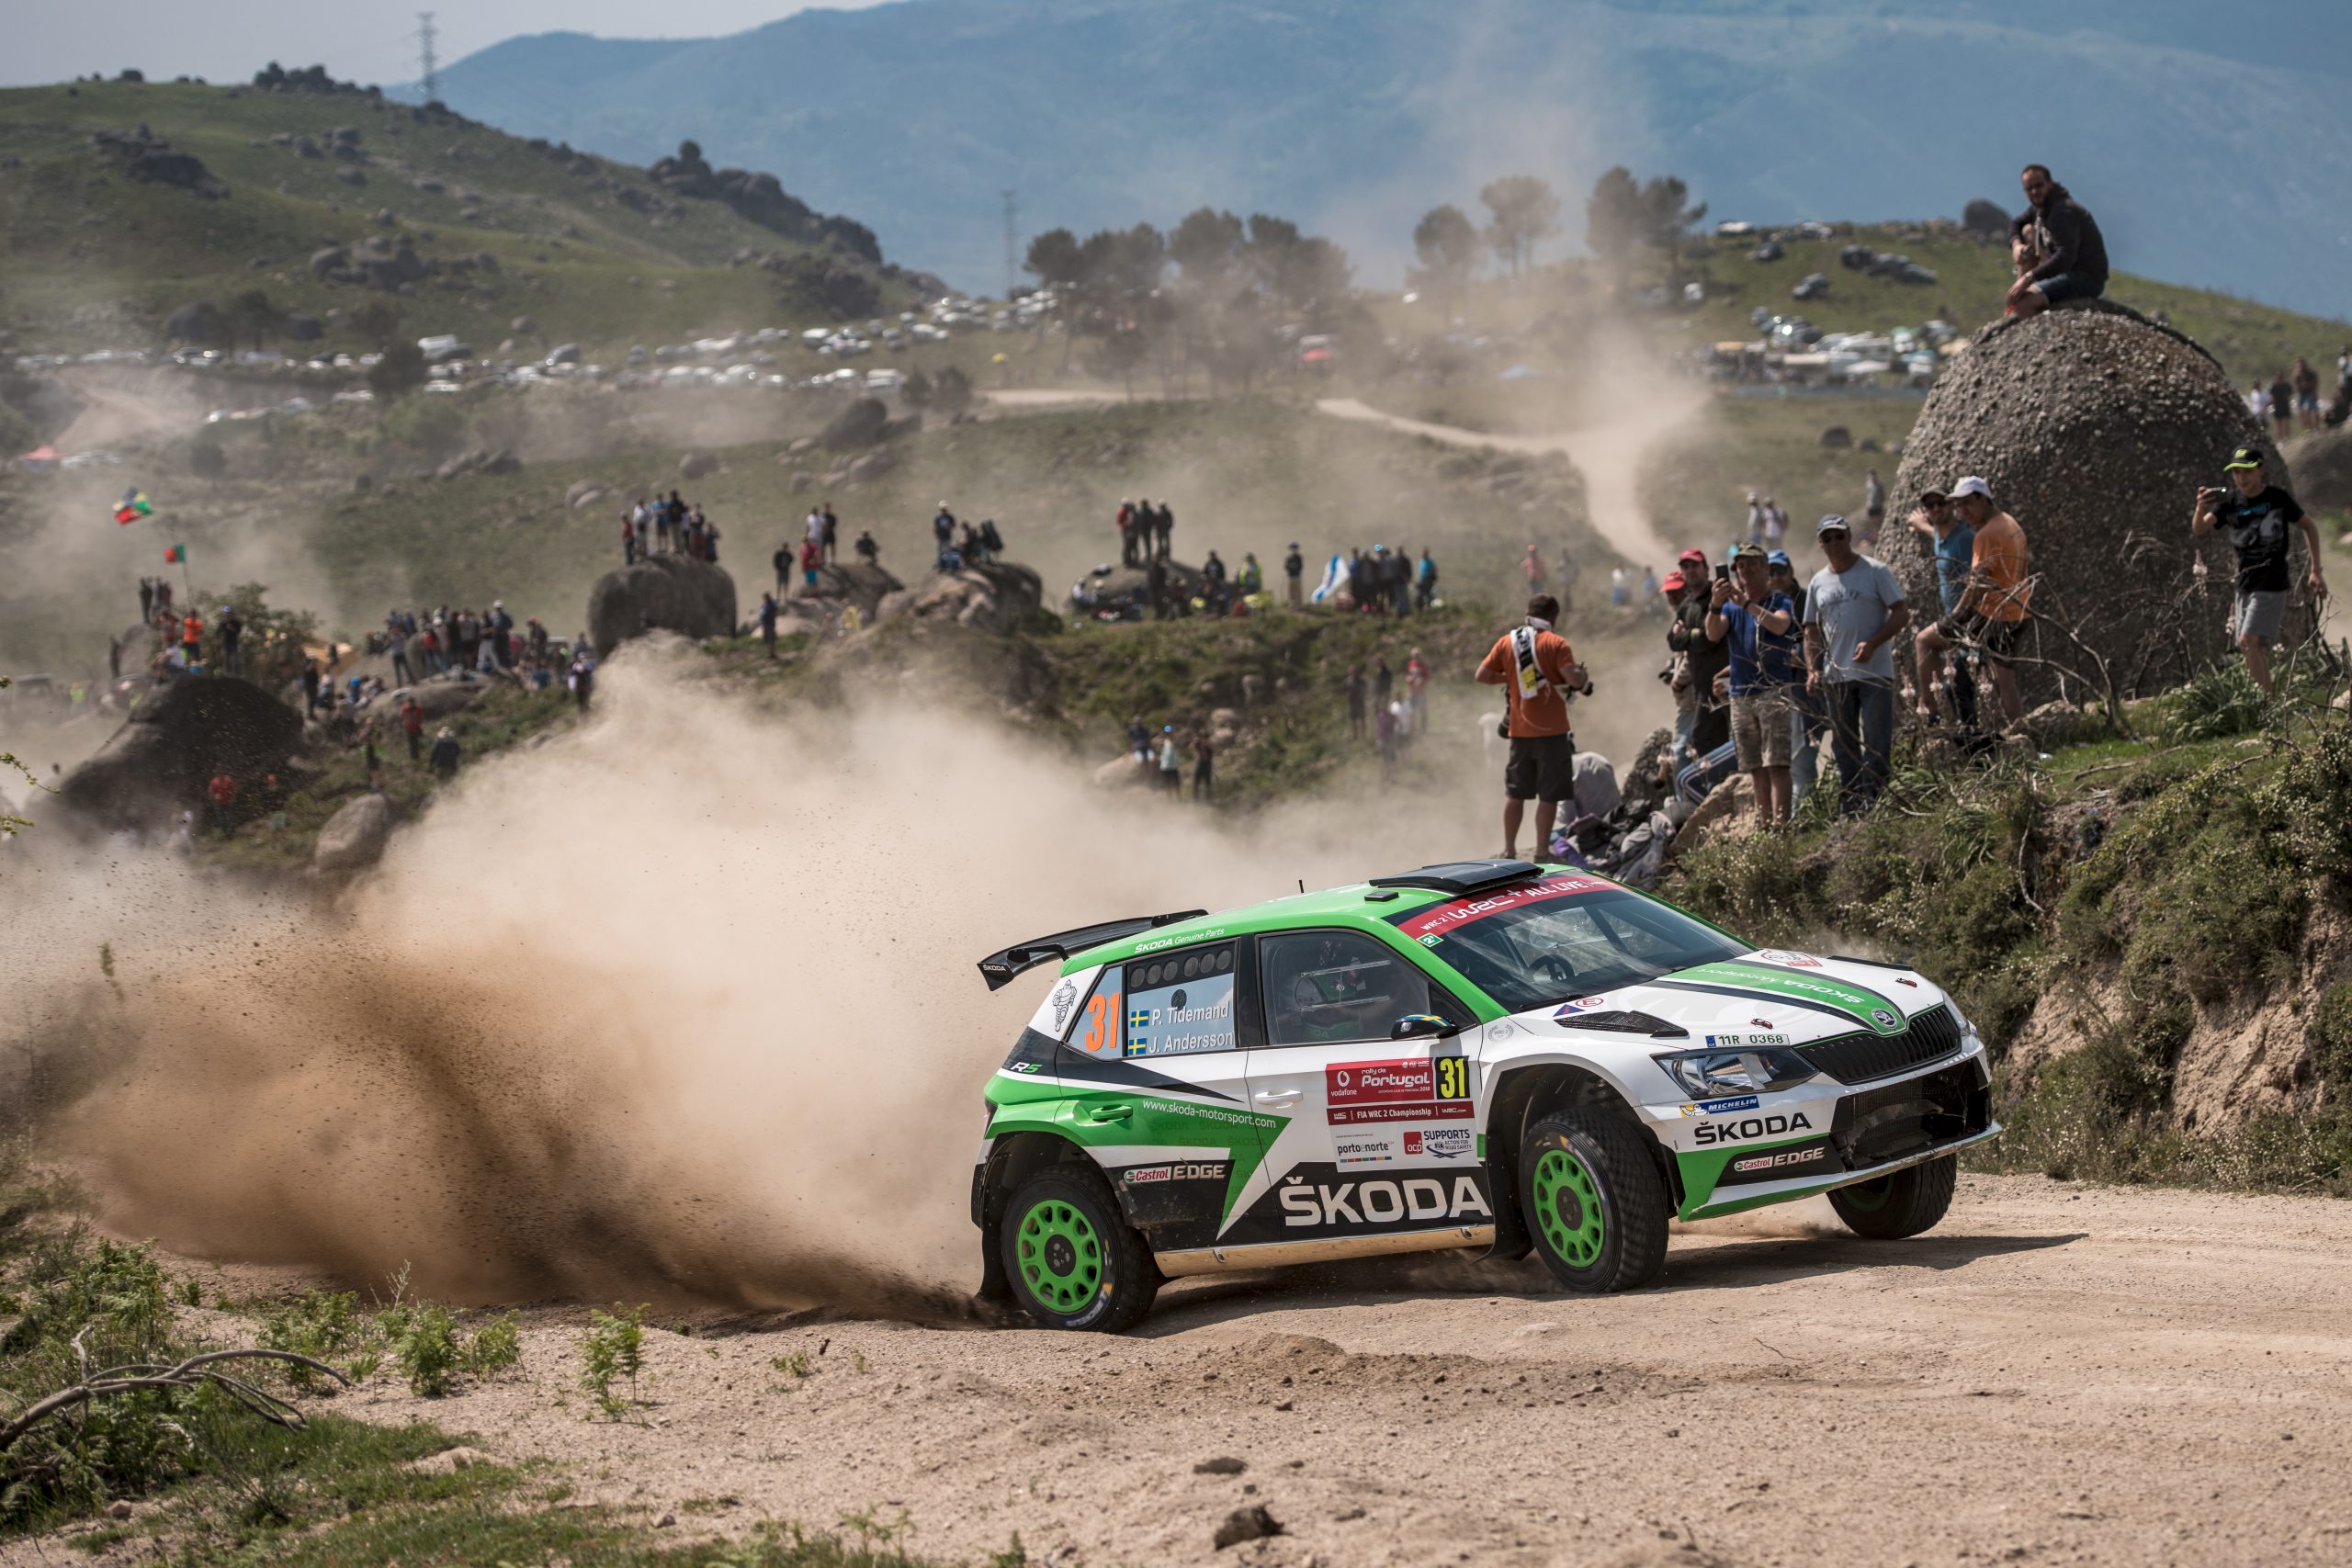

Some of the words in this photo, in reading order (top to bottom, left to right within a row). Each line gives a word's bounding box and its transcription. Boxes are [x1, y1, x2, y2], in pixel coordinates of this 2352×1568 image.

[1421, 919, 1441, 931] WRC
[1524, 884, 1557, 897] ALL
[1558, 880, 1589, 892] LIVE
[1135, 938, 1173, 953] ŠKODA
[1174, 932, 1204, 945] Genuine
[1204, 928, 1225, 939] Parts
[983, 964, 1006, 972] ŠKODA
[1086, 992, 1121, 1052] 31
[1152, 1009, 1163, 1026] P.
[1167, 1001, 1230, 1024] Tidemand
[1149, 1038, 1160, 1054] J.
[1165, 1032, 1234, 1052] Andersson
[1719, 1035, 1739, 1045] 11R
[1749, 1034, 1783, 1044] 0368
[1010, 1062, 1043, 1073] R5
[1440, 1058, 1465, 1099] 31
[1362, 1072, 1430, 1089] Portugal
[1330, 1089, 1357, 1097] vodafone
[1143, 1100, 1276, 1129] www.skoda-motorsport.com
[1357, 1111, 1367, 1120] FIA
[1368, 1110, 1383, 1119] WRC
[1389, 1108, 1431, 1118] Championship
[1709, 1099, 1757, 1111] MICHELIN
[1424, 1129, 1471, 1140] SUPPORTS
[1694, 1112, 1813, 1145] ŠKODA
[1743, 1159, 1770, 1169] Castrol
[1774, 1147, 1825, 1167] EDGE
[1136, 1168, 1169, 1181] Castrol
[1172, 1164, 1227, 1180] EDGE
[1279, 1176, 1493, 1226] ŠKODA
